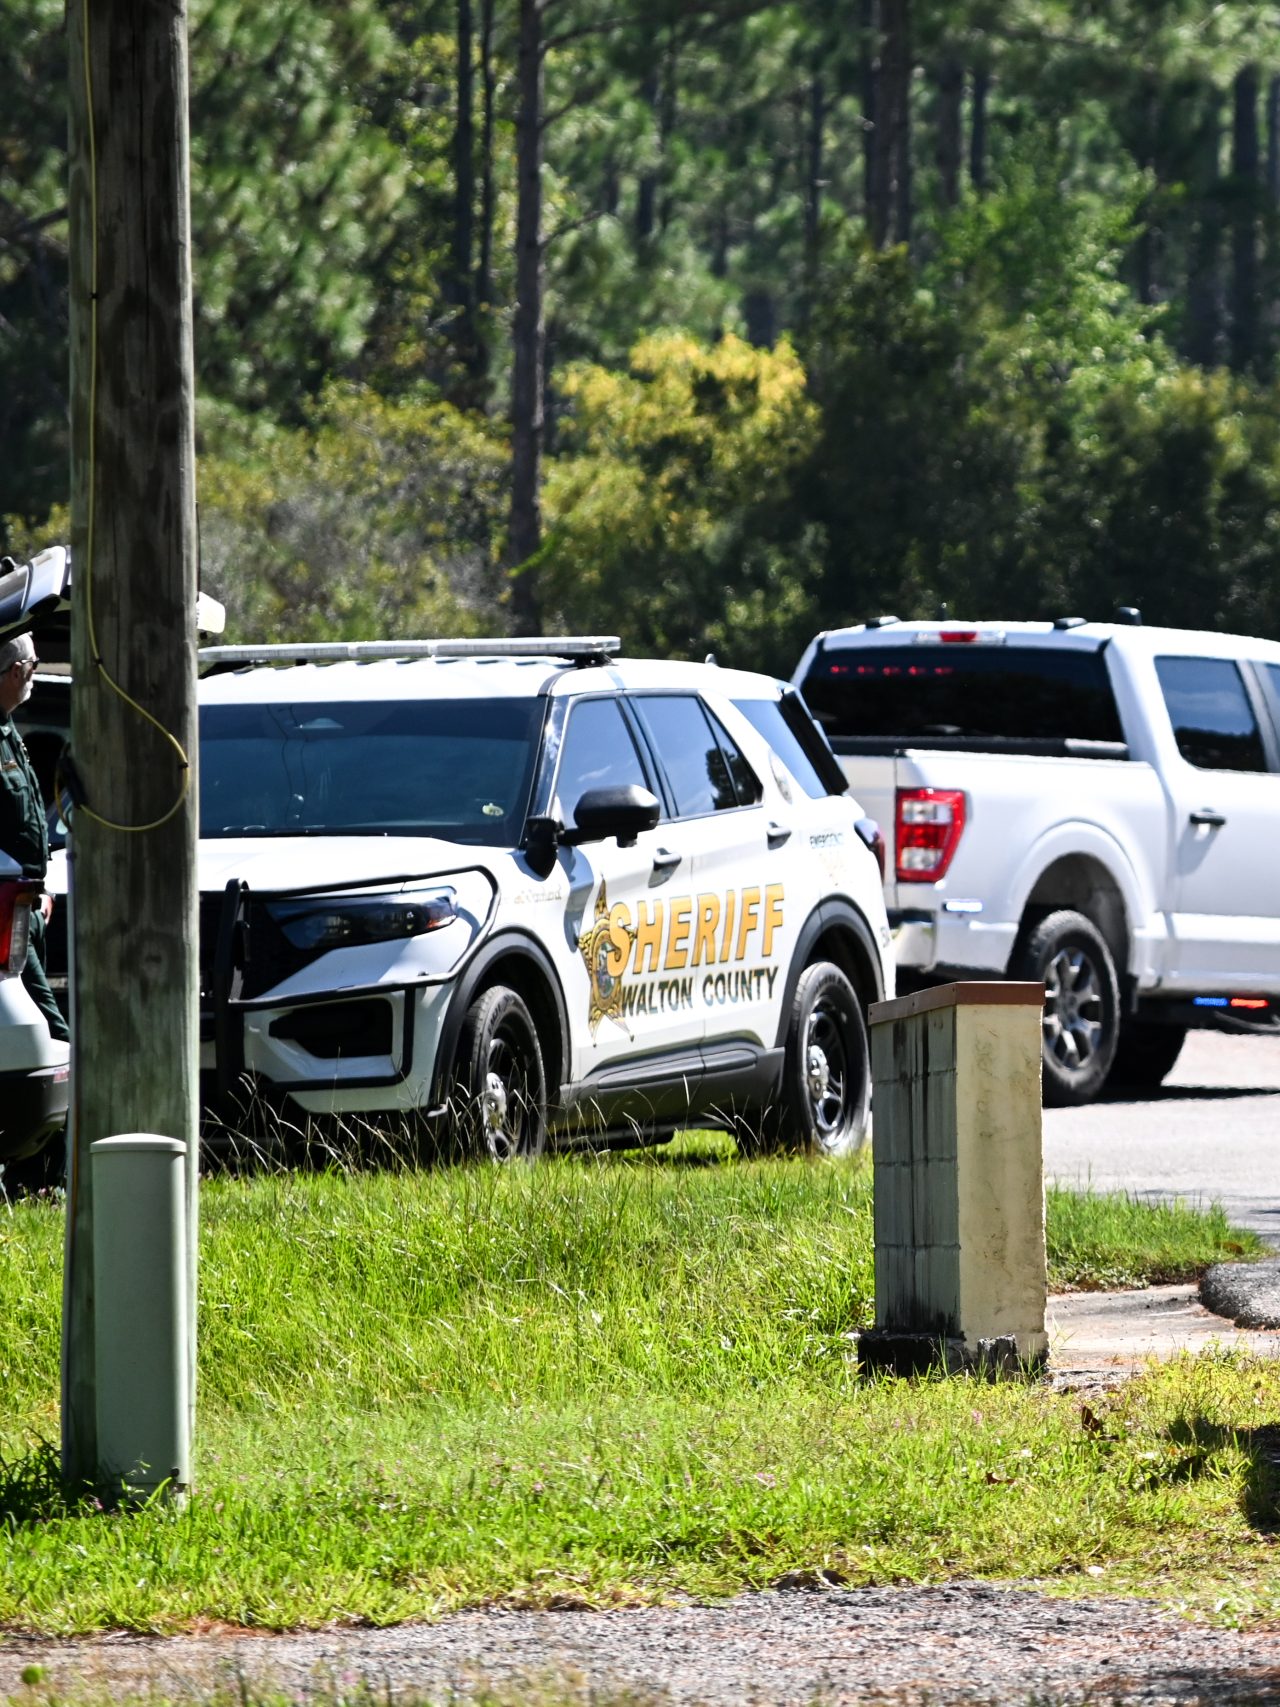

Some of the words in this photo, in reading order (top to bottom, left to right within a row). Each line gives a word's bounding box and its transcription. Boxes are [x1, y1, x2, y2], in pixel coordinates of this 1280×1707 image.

[607, 883, 784, 979] SHERIFF
[621, 976, 694, 1018] WALTON
[702, 966, 779, 1006] COUNTY
